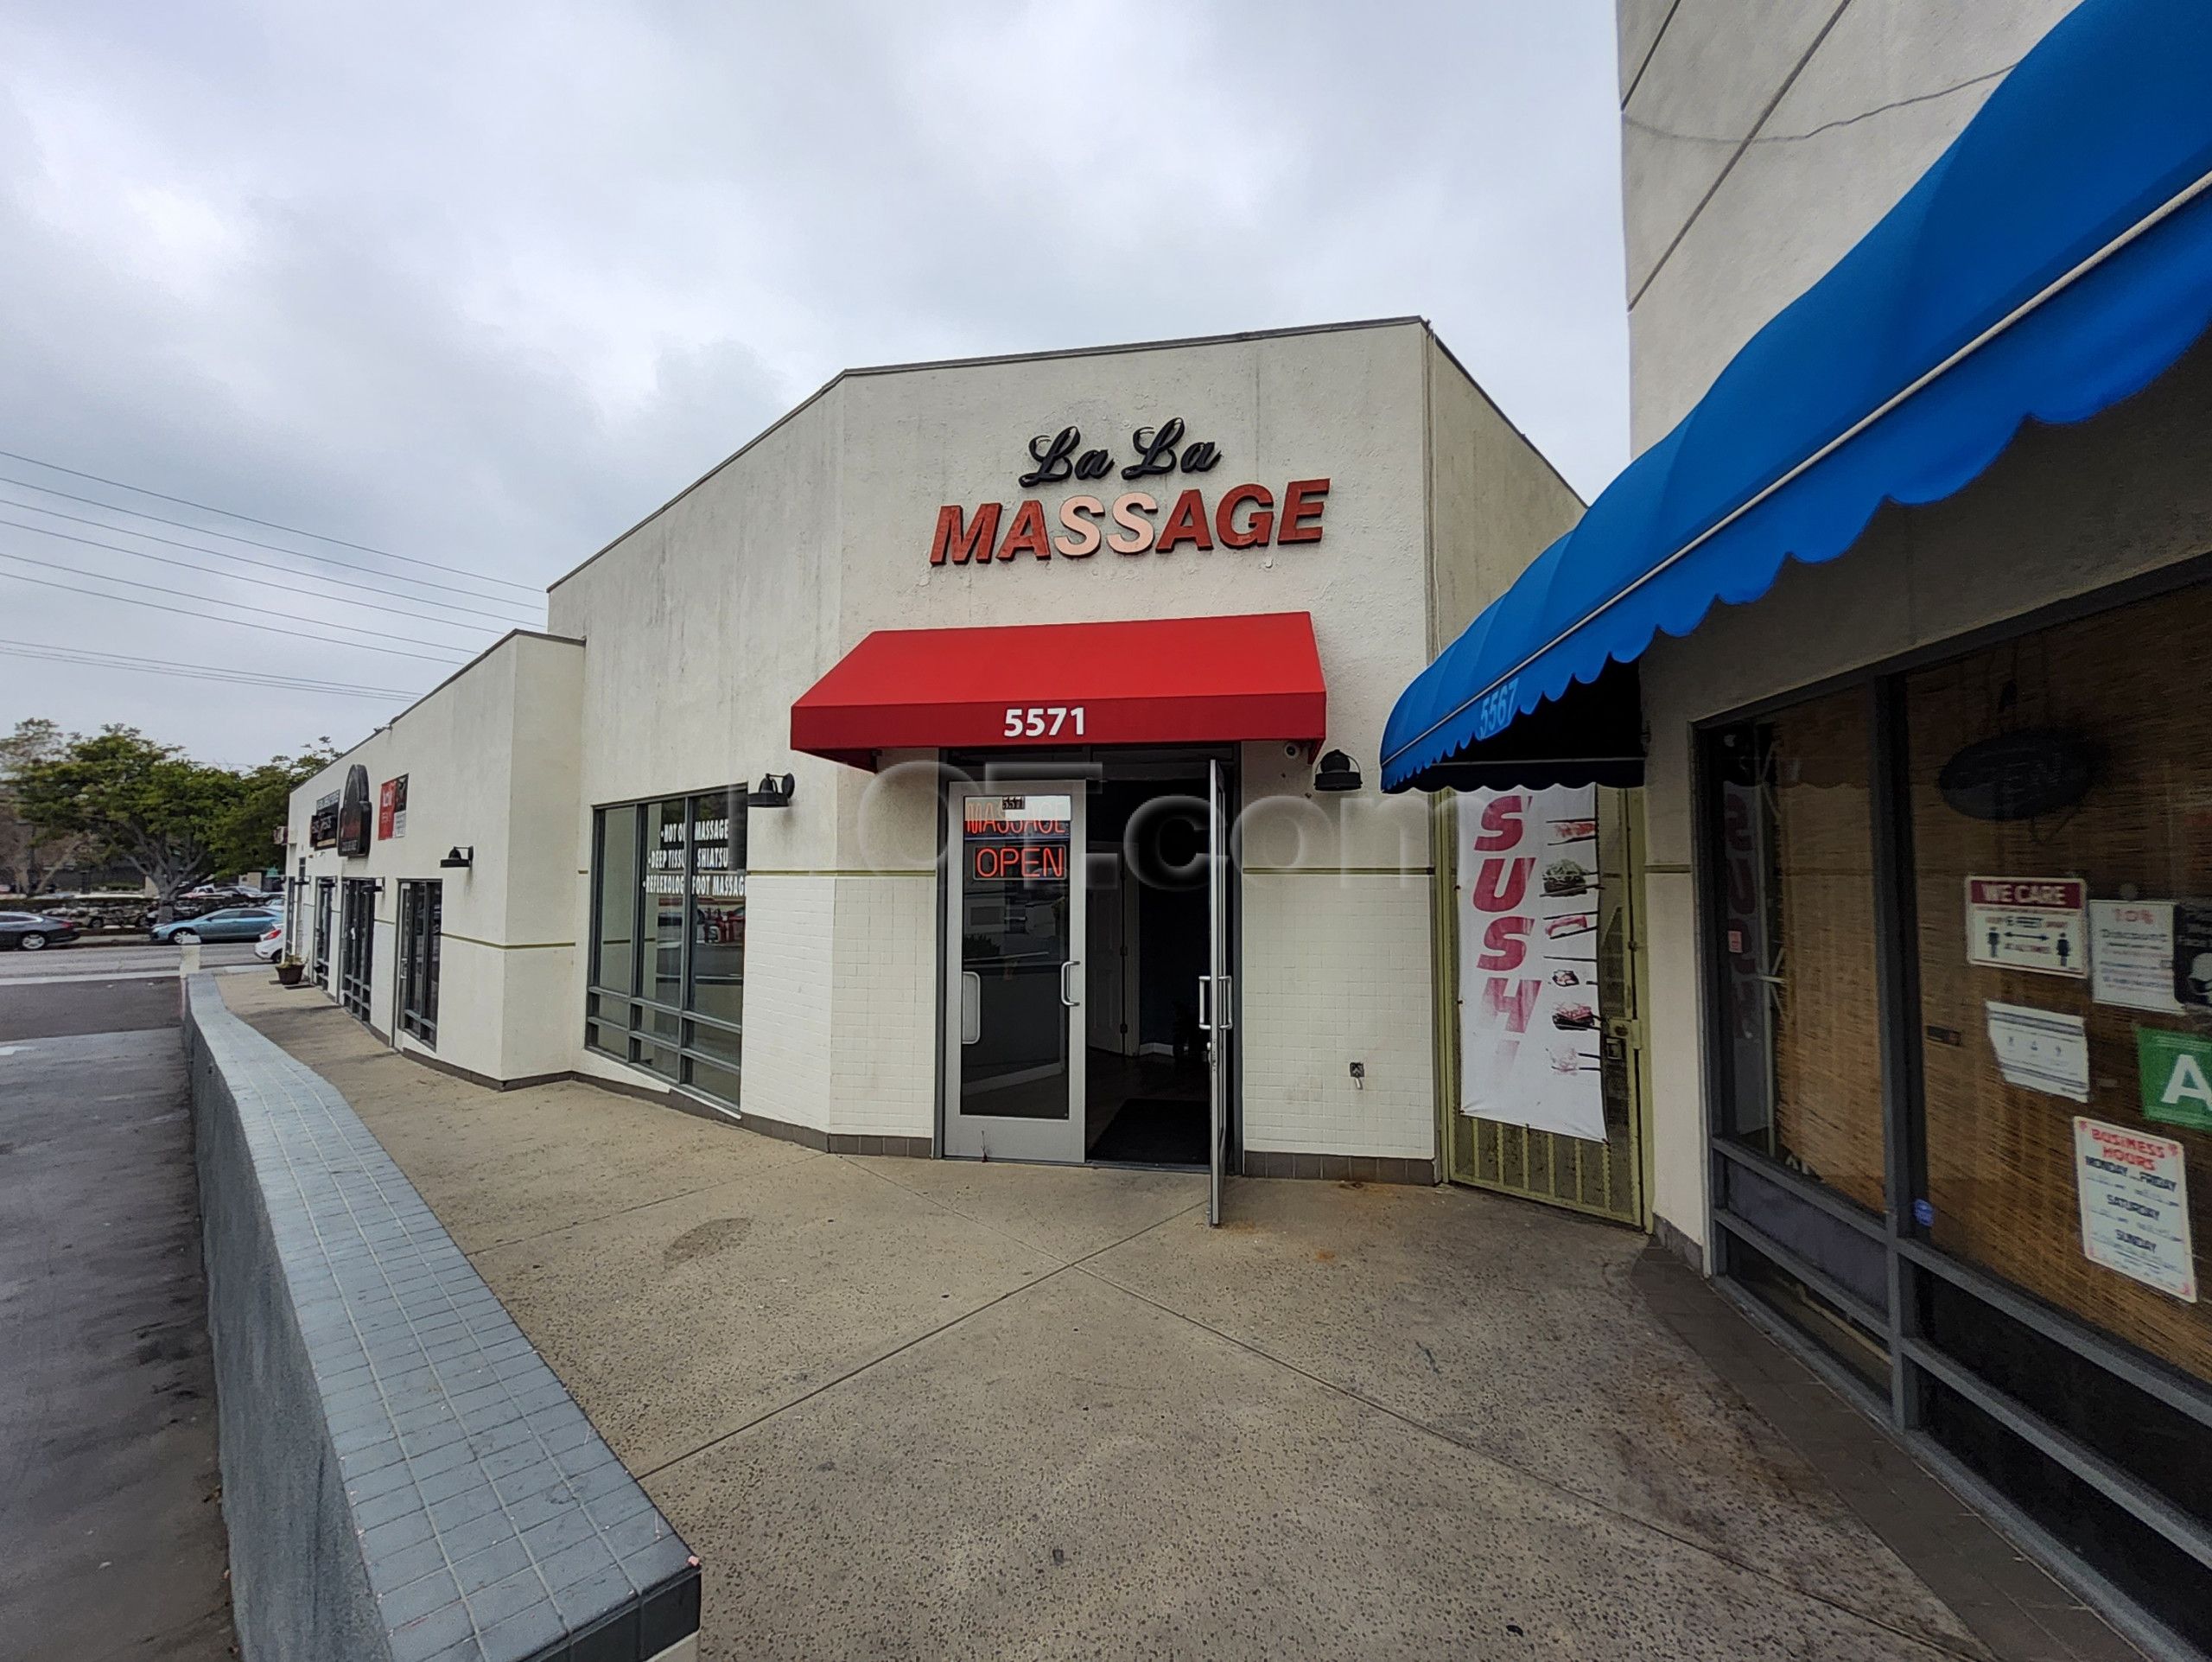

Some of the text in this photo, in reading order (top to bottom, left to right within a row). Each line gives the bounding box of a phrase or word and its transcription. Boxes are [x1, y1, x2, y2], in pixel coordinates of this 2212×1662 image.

[1018, 417, 1223, 487] La La
[929, 478, 1331, 565] MASSAGE
[1479, 677, 1520, 739] 5567
[1004, 707, 1084, 737] 5571
[694, 818, 729, 841] MASSAGE
[652, 850, 667, 869] DEEP
[697, 848, 728, 869] SHIATSU
[646, 876, 684, 894] REFLEXOLOG
[692, 876, 710, 895] FOOT
[1980, 883, 2066, 905] WE CARE
[2161, 1054, 2212, 1112] A
[2091, 1128, 2165, 1159] BUSINESS
[2085, 1155, 2128, 1176] MONDAY
[2103, 1147, 2156, 1171] HOURS
[2107, 1194, 2160, 1221] SATURDAY
[2115, 1228, 2157, 1254] SUNDAY
